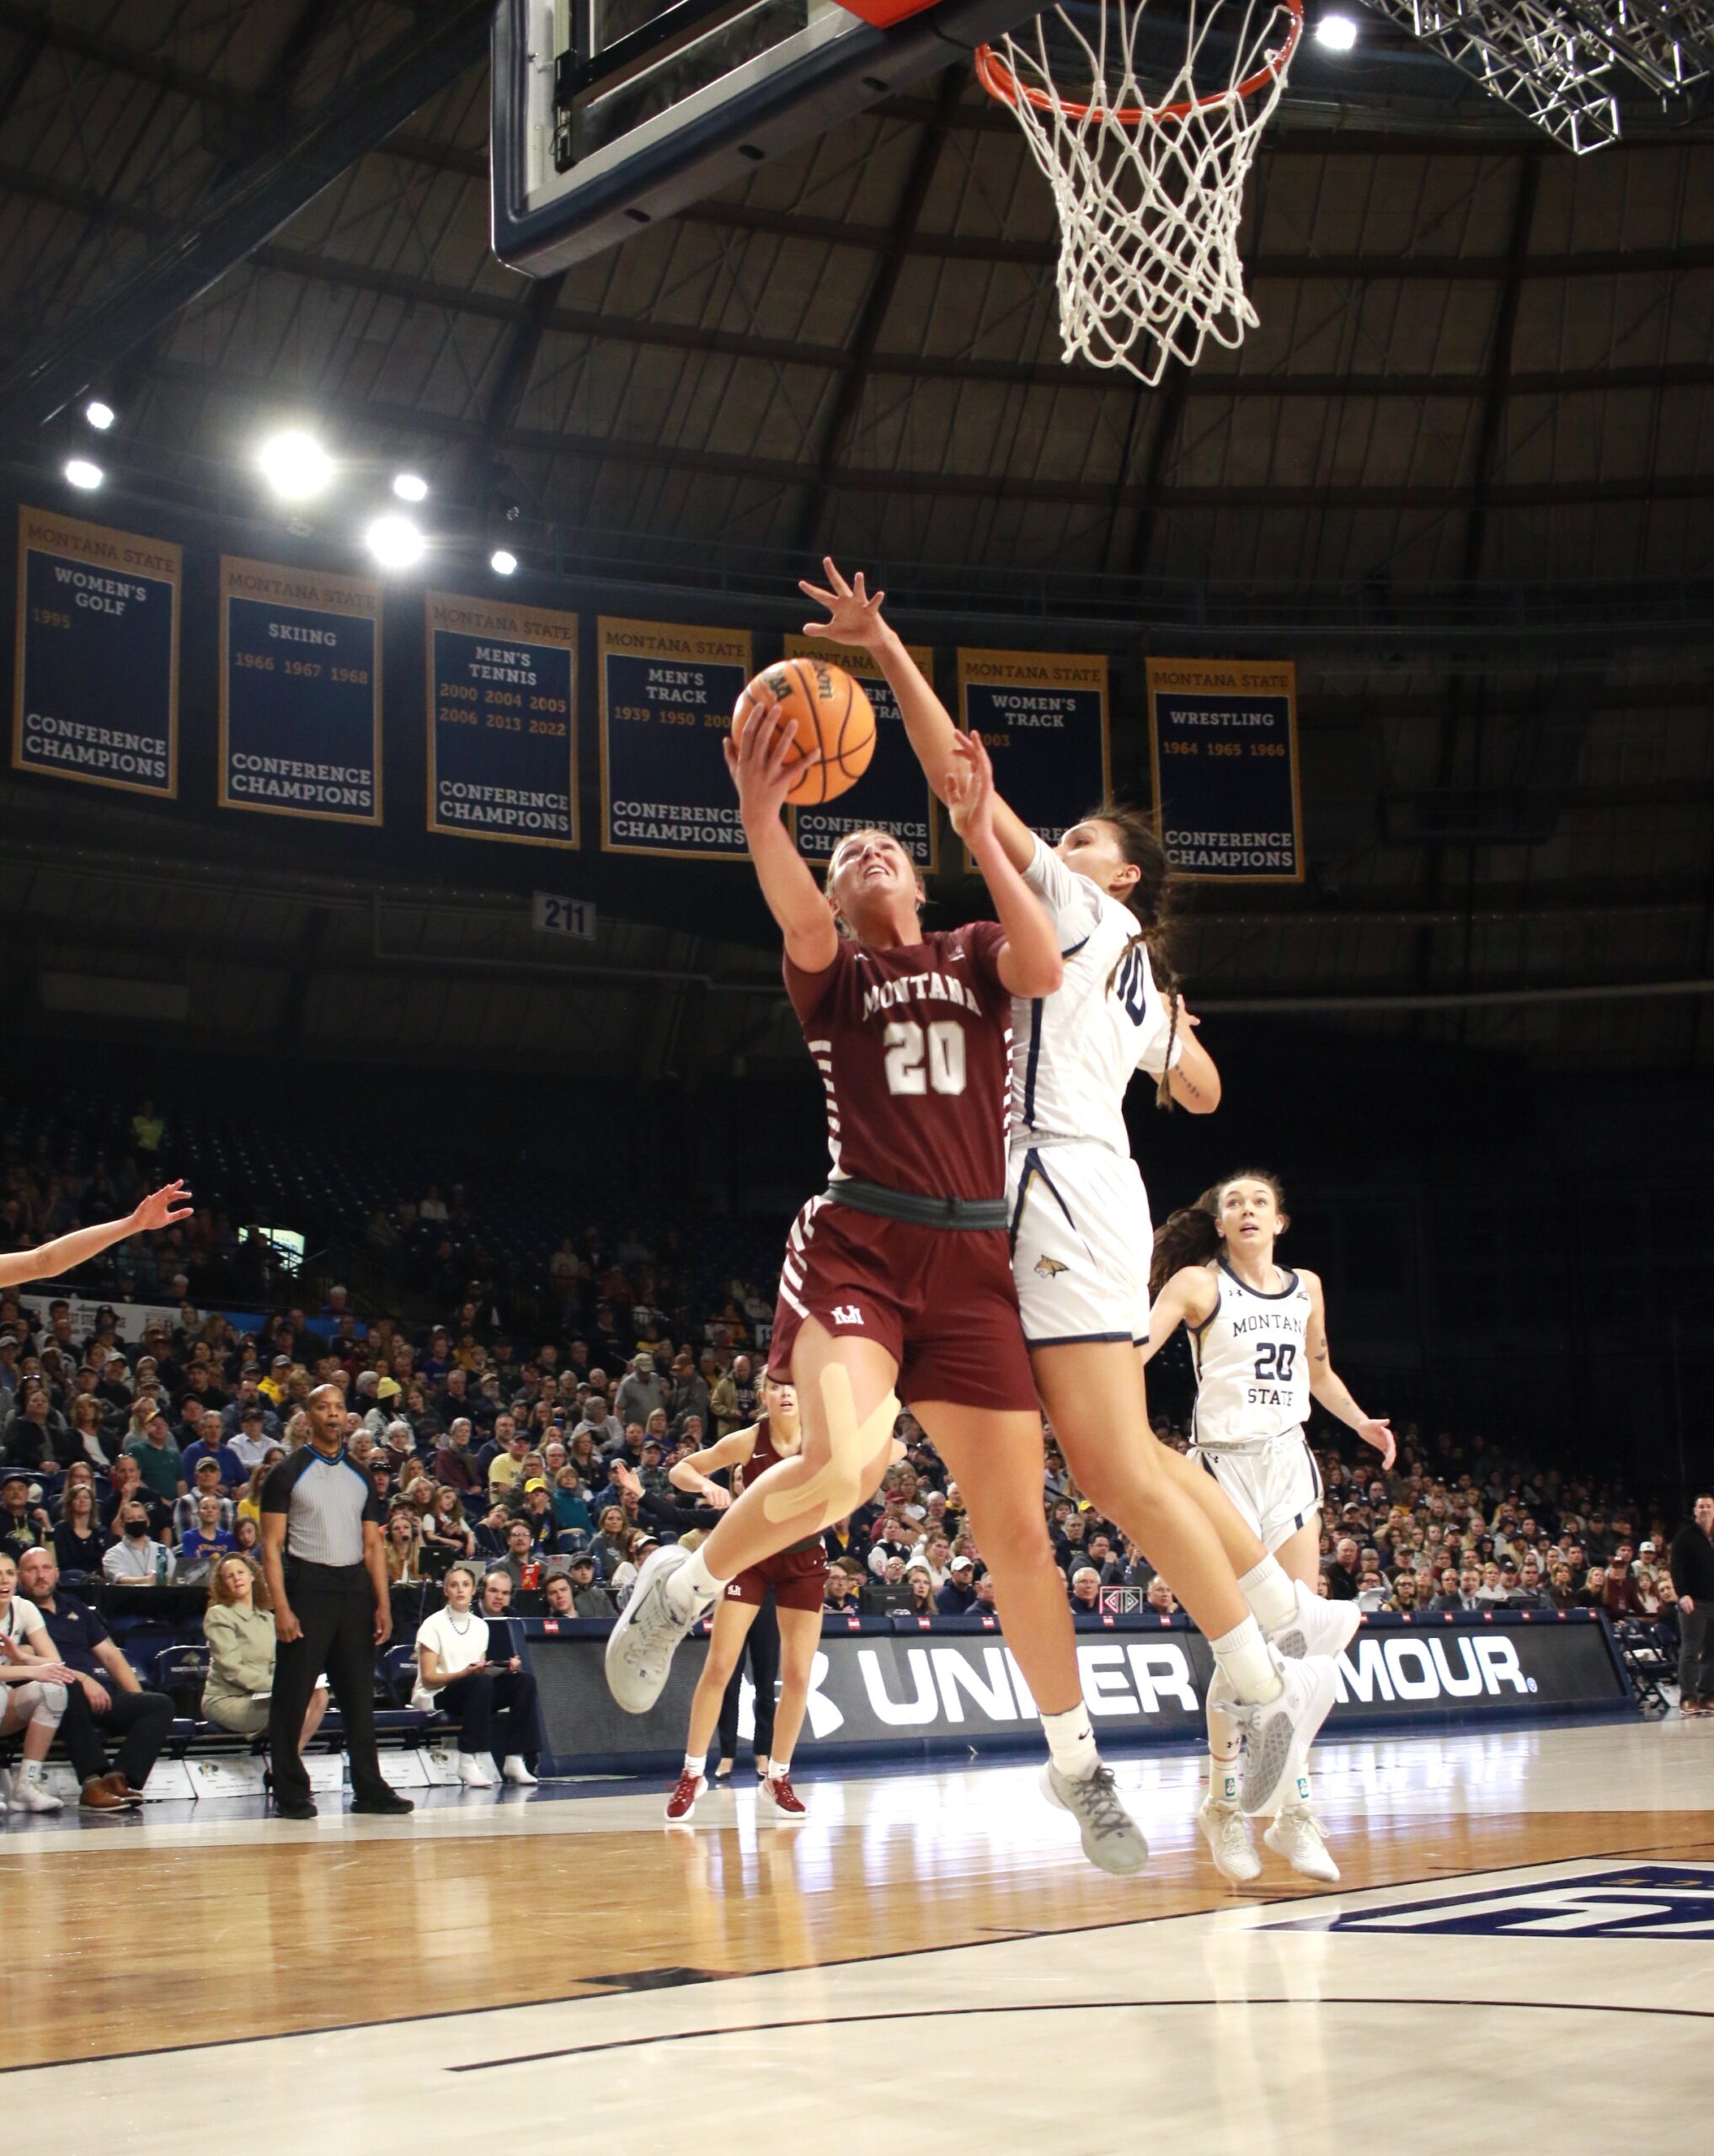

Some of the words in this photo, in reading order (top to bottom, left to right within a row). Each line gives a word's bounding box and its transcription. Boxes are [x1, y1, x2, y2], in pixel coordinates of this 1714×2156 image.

[27, 524, 119, 559] MONTANA
[123, 547, 174, 573] STATE
[55, 567, 147, 601] WOMEN'S
[228, 573, 319, 601] MONTANA
[324, 587, 375, 609] STATE
[76, 593, 125, 616] GOLF
[33, 608, 71, 629] 1995
[434, 606, 517, 633] MONTANA
[523, 622, 572, 640] STATE
[269, 623, 337, 646] SKIING
[606, 632, 691, 654] MONTANA
[697, 641, 745, 657] STATE
[236, 652, 275, 671] 1966
[284, 660, 321, 678] 1967
[331, 667, 368, 685] 1968
[475, 647, 531, 667] MEN'S
[469, 664, 537, 686] TENNIS
[648, 669, 704, 686] MEN'S
[966, 662, 1049, 680] MONTANA
[1053, 667, 1101, 682] STATE
[1154, 671, 1236, 687] MONTANA
[1241, 675, 1289, 688] STATE
[440, 683, 478, 701] 2000
[485, 691, 522, 707] 2004
[530, 696, 566, 712] 2005
[646, 686, 707, 704] TRACK
[992, 694, 1076, 711] WOMEN'S
[440, 707, 478, 725] 2006
[486, 714, 521, 731] 2013
[529, 720, 566, 736] 2022
[614, 706, 650, 722] 1939
[659, 710, 695, 726] 1950
[704, 713, 732, 728] 200
[1005, 712, 1065, 728] TRACK
[1171, 711, 1275, 727] WRESTLING
[27, 713, 167, 756] CONFERENCE
[980, 733, 1010, 747] 003
[26, 735, 166, 778] CHAMPIONS
[1163, 741, 1199, 755] 1964
[1207, 743, 1241, 756] 1965
[1250, 744, 1285, 757] 1966
[232, 753, 371, 785] CONFERENCE
[232, 775, 371, 807] CHAMPIONS
[440, 781, 569, 811] CONFERENCE
[440, 801, 569, 832] CHAMPIONS
[613, 820, 745, 845] CHAMPIONS
[1165, 830, 1292, 848] CONFERENCE
[1165, 849, 1294, 867] CHAMPIONS
[544, 898, 585, 934] 211
[862, 971, 983, 1022] MONTANA
[884, 1020, 967, 1095] 20
[1254, 1342, 1296, 1382] 20
[1248, 1388, 1294, 1406] STATE
[1333, 1636, 1530, 1704] MOUR
